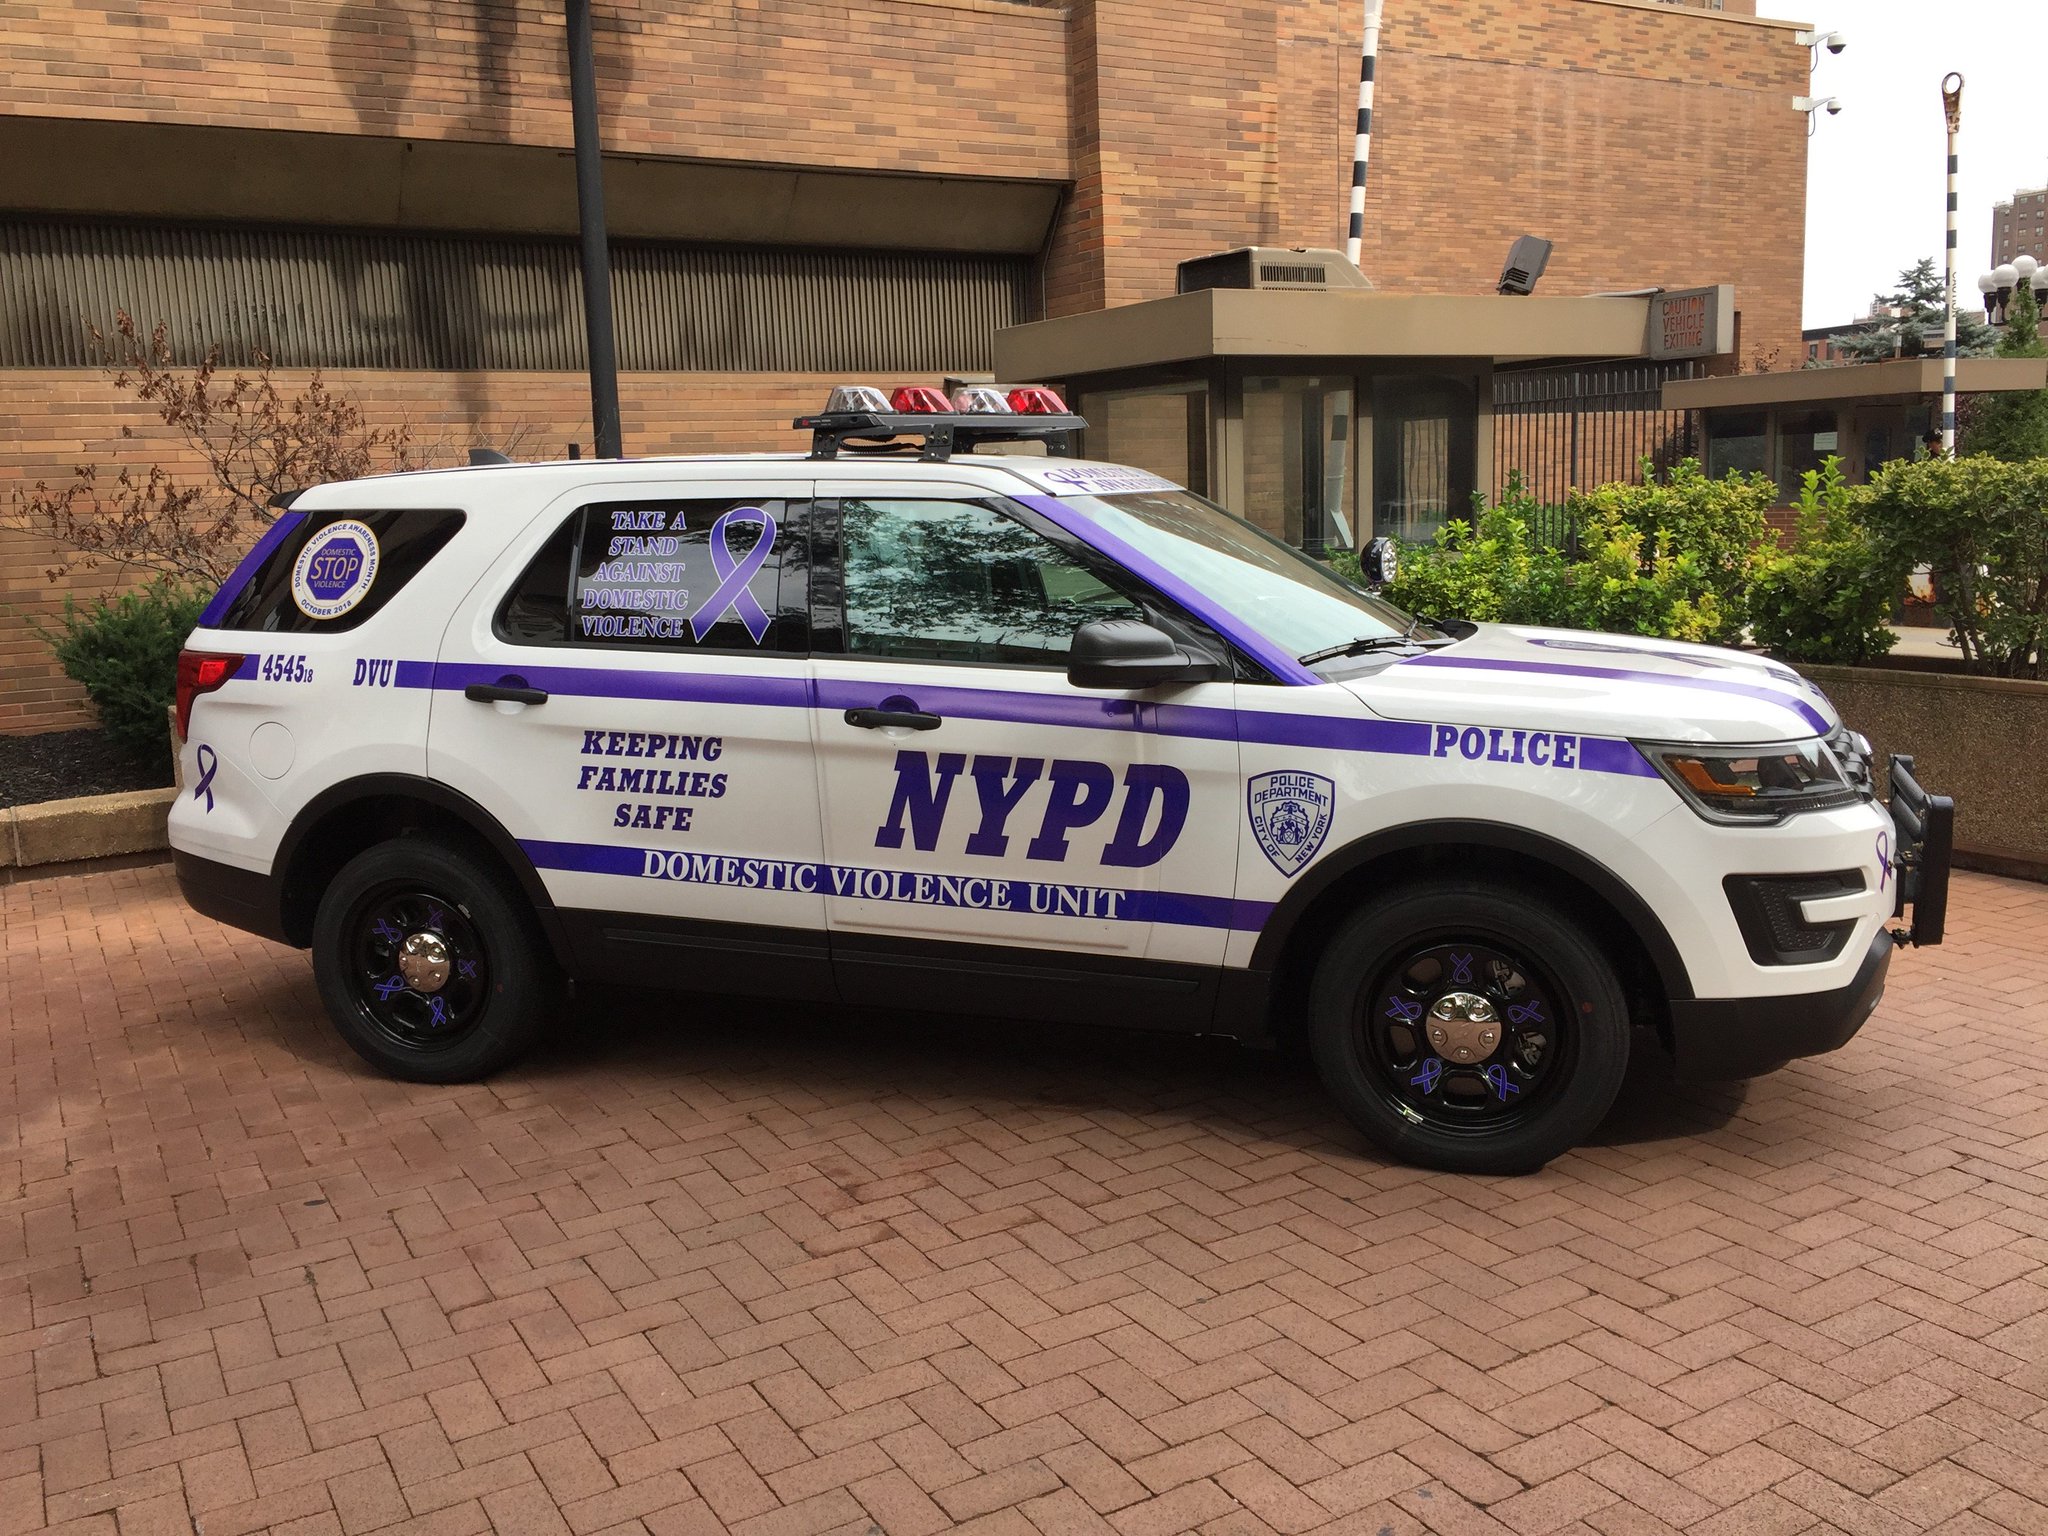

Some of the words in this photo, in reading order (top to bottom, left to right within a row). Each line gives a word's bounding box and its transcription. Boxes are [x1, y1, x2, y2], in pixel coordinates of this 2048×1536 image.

[1662, 296, 1705, 317] CAUTION
[1662, 312, 1705, 333] VEHICLE
[1663, 330, 1703, 350] EXITING
[611, 511, 665, 531] TAKE
[672, 511, 687, 530] A
[311, 523, 347, 545] VIOLENCE
[348, 524, 376, 557] AWARENESS
[321, 548, 356, 556] DOMESTIC
[608, 536, 679, 556] STAND
[295, 546, 312, 588] DOMESTIC
[310, 557, 359, 580] STOP
[361, 558, 376, 590] MONTH
[593, 562, 685, 583] AGAINST
[314, 580, 347, 588] VIOLENCE
[301, 599, 332, 615] OCTOBER
[334, 600, 352, 614] 2018
[582, 588, 689, 610] DOMESTIC
[581, 616, 684, 637] VIOLENCE
[262, 654, 306, 683] 4545
[353, 658, 393, 688] DVU
[581, 730, 723, 762] KEEPING
[1433, 724, 1577, 769] POLICE
[577, 765, 728, 799] FAMILIES
[1270, 775, 1315, 789] POLICE
[1254, 787, 1329, 807] DEPARTMENT
[614, 803, 694, 832] SAFE
[874, 749, 1190, 868] NYPD
[1254, 815, 1270, 842] CITY
[1266, 843, 1280, 858] OF
[1294, 841, 1315, 864] NEW
[1311, 813, 1328, 840] YORK
[641, 850, 818, 894] DOMESTIC
[830, 866, 1012, 910] VIOLENCE
[1028, 883, 1127, 919] UNIT
